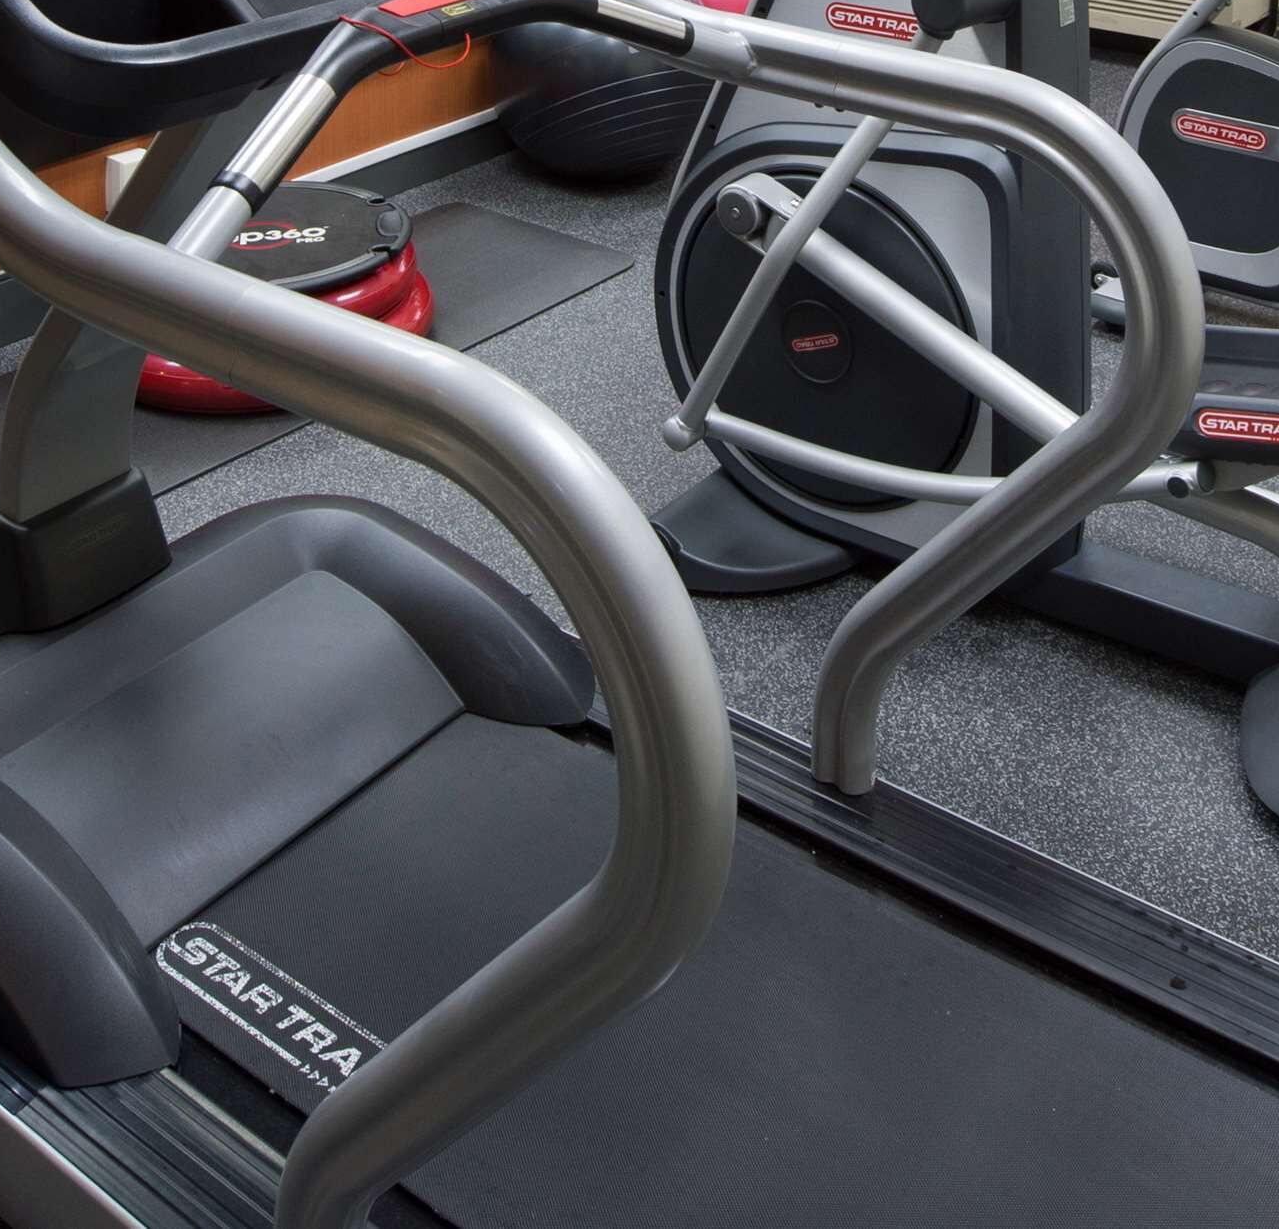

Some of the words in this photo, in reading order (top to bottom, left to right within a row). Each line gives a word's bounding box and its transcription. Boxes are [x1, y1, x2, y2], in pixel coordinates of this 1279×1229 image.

[834, 10, 875, 27] STAR
[876, 17, 920, 34] TRAC
[1182, 121, 1218, 136] STAR
[1221, 129, 1259, 144] TRAC
[231, 227, 327, 246] p360
[295, 236, 325, 244] PRO
[1205, 418, 1249, 432] STAR
[173, 936, 284, 1015] STAR
[275, 1004, 364, 1077] TRA
